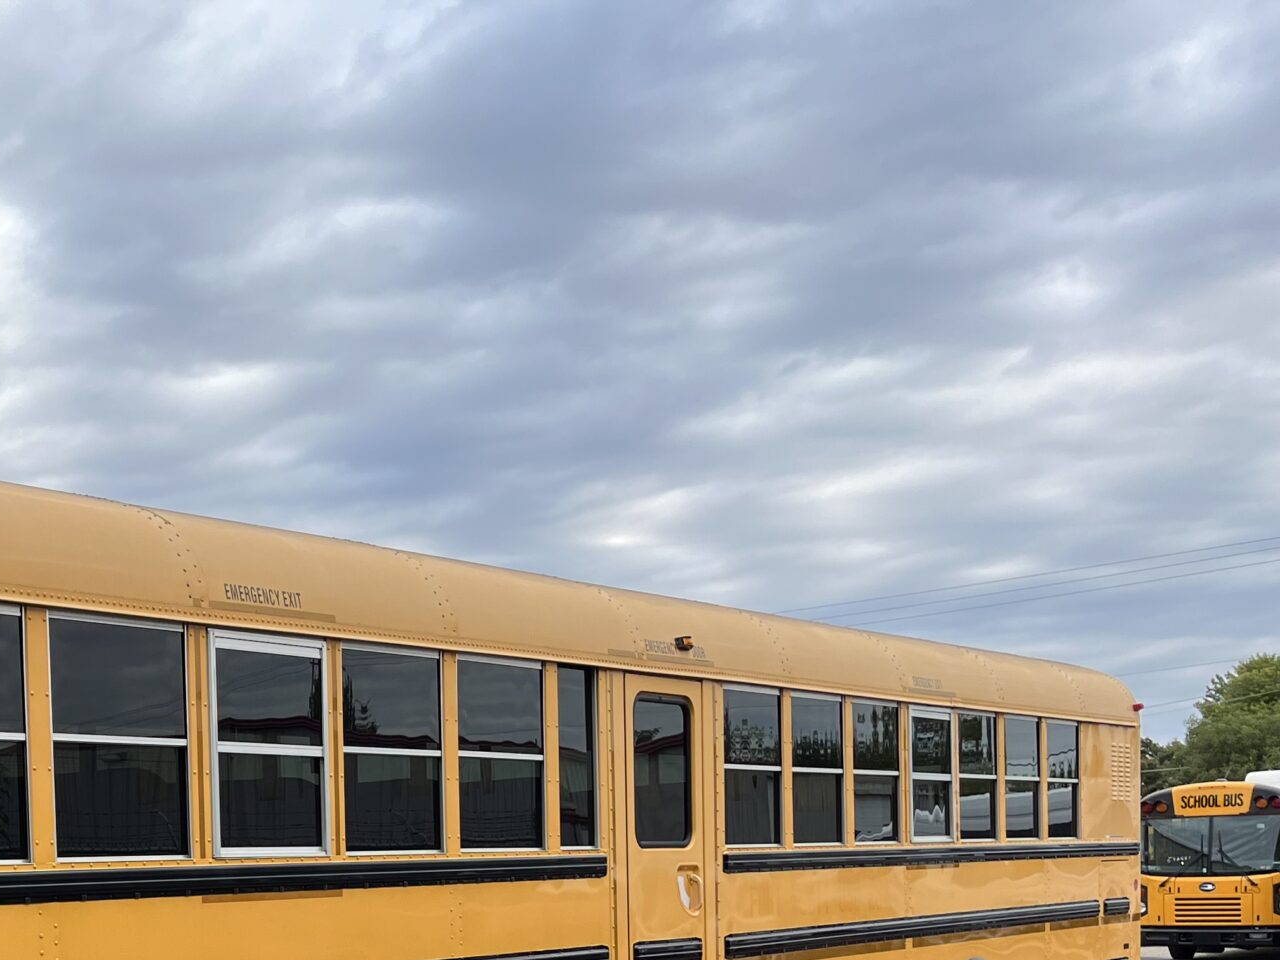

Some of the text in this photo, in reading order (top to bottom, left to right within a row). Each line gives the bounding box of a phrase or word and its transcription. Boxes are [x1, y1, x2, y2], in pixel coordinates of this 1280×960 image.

[223, 583, 302, 608] EMERGENCY EXIT
[1180, 793, 1244, 809] SCHOOL BUS
